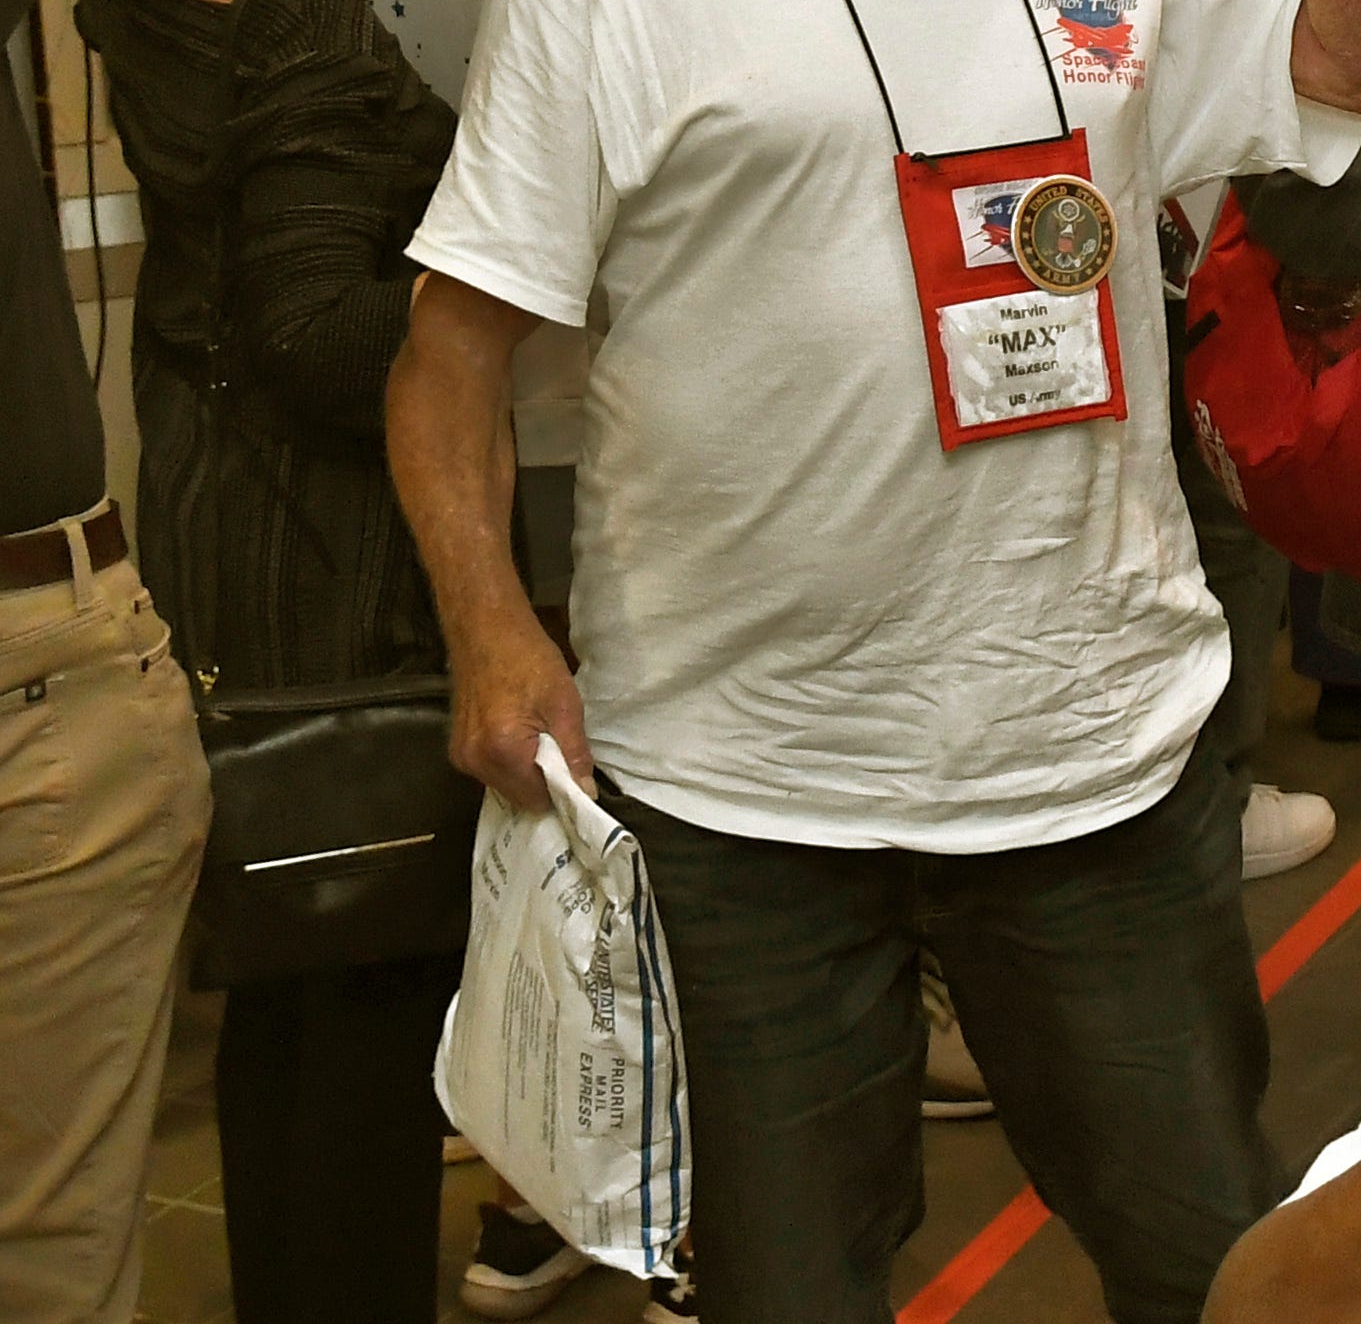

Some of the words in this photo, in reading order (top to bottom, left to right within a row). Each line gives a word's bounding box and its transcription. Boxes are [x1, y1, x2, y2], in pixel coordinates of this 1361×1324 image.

[1063, 69, 1113, 85] Honor
[1030, 186, 1068, 212] UNITED
[1043, 267, 1081, 283] ARMY
[1000, 304, 1049, 321] Marvin
[1004, 360, 1060, 378] Maxson
[1009, 392, 1027, 407] US
[1030, 389, 1062, 405] Army
[577, 1051, 594, 1130] EXPRESS
[594, 1074, 608, 1113] MAIL
[610, 1056, 626, 1131] PRIORITY
